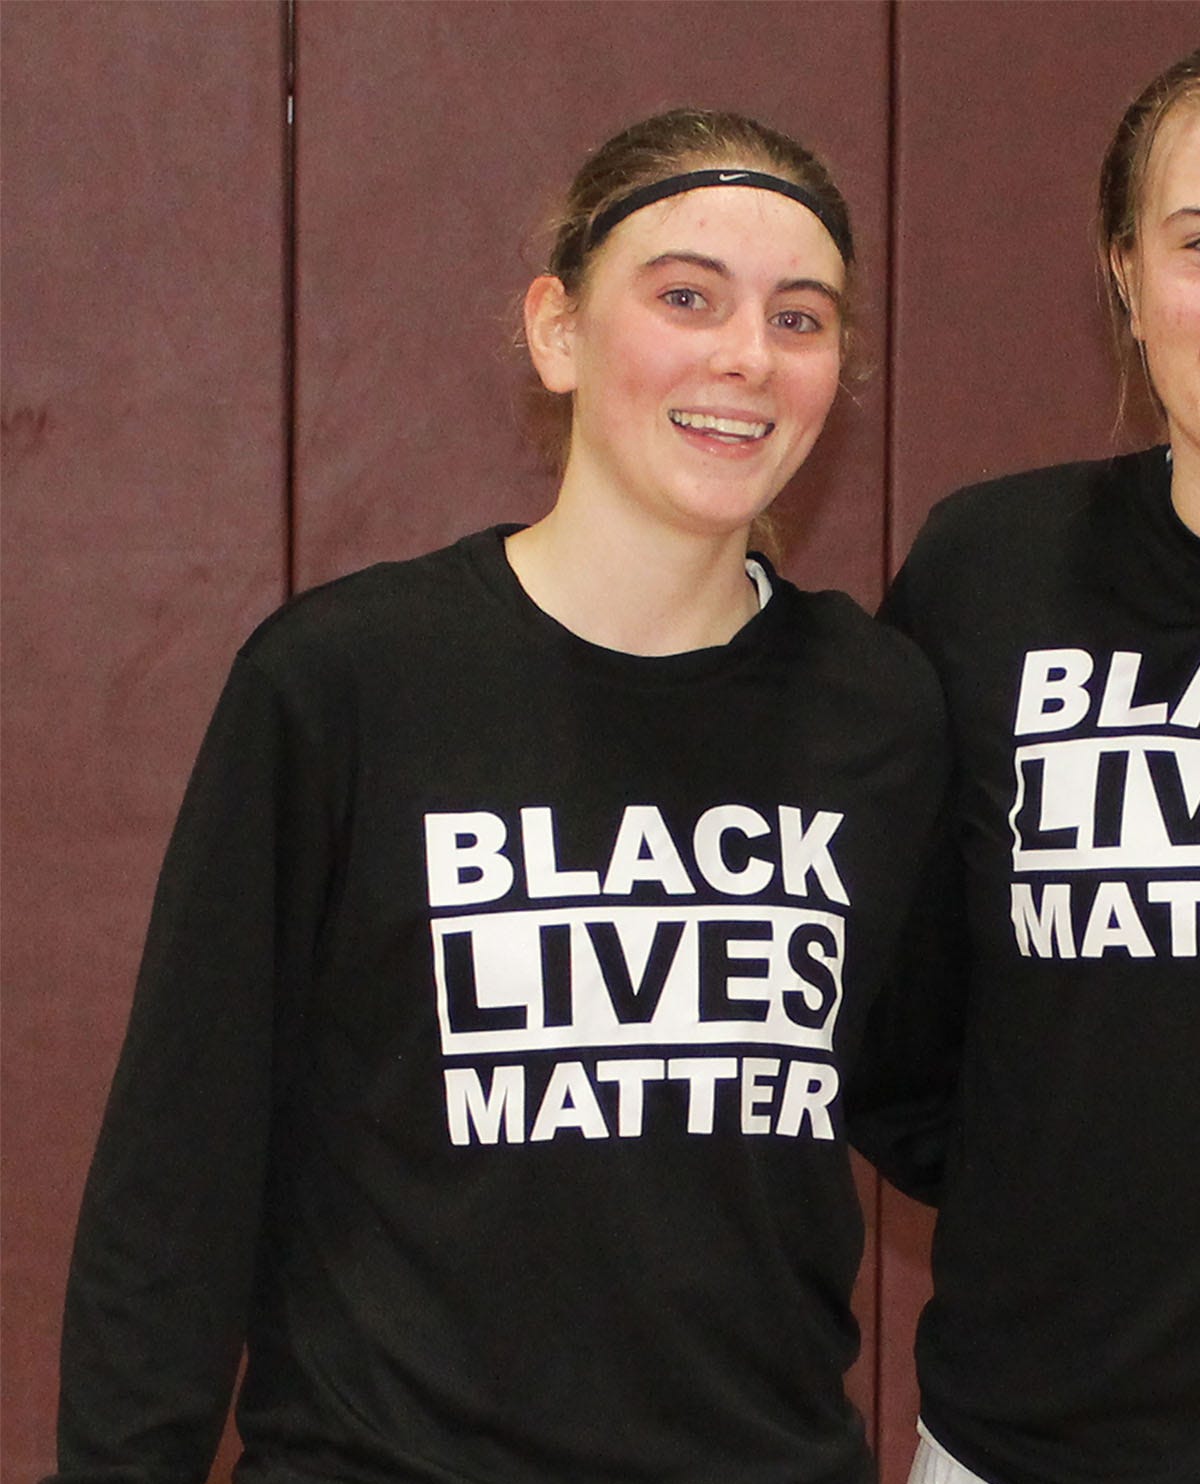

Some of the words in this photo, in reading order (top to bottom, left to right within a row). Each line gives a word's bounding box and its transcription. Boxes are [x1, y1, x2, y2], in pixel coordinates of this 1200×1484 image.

[424, 804, 850, 907] BLACK
[440, 920, 839, 1034] LIVES
[443, 1057, 840, 1146] MATTER
